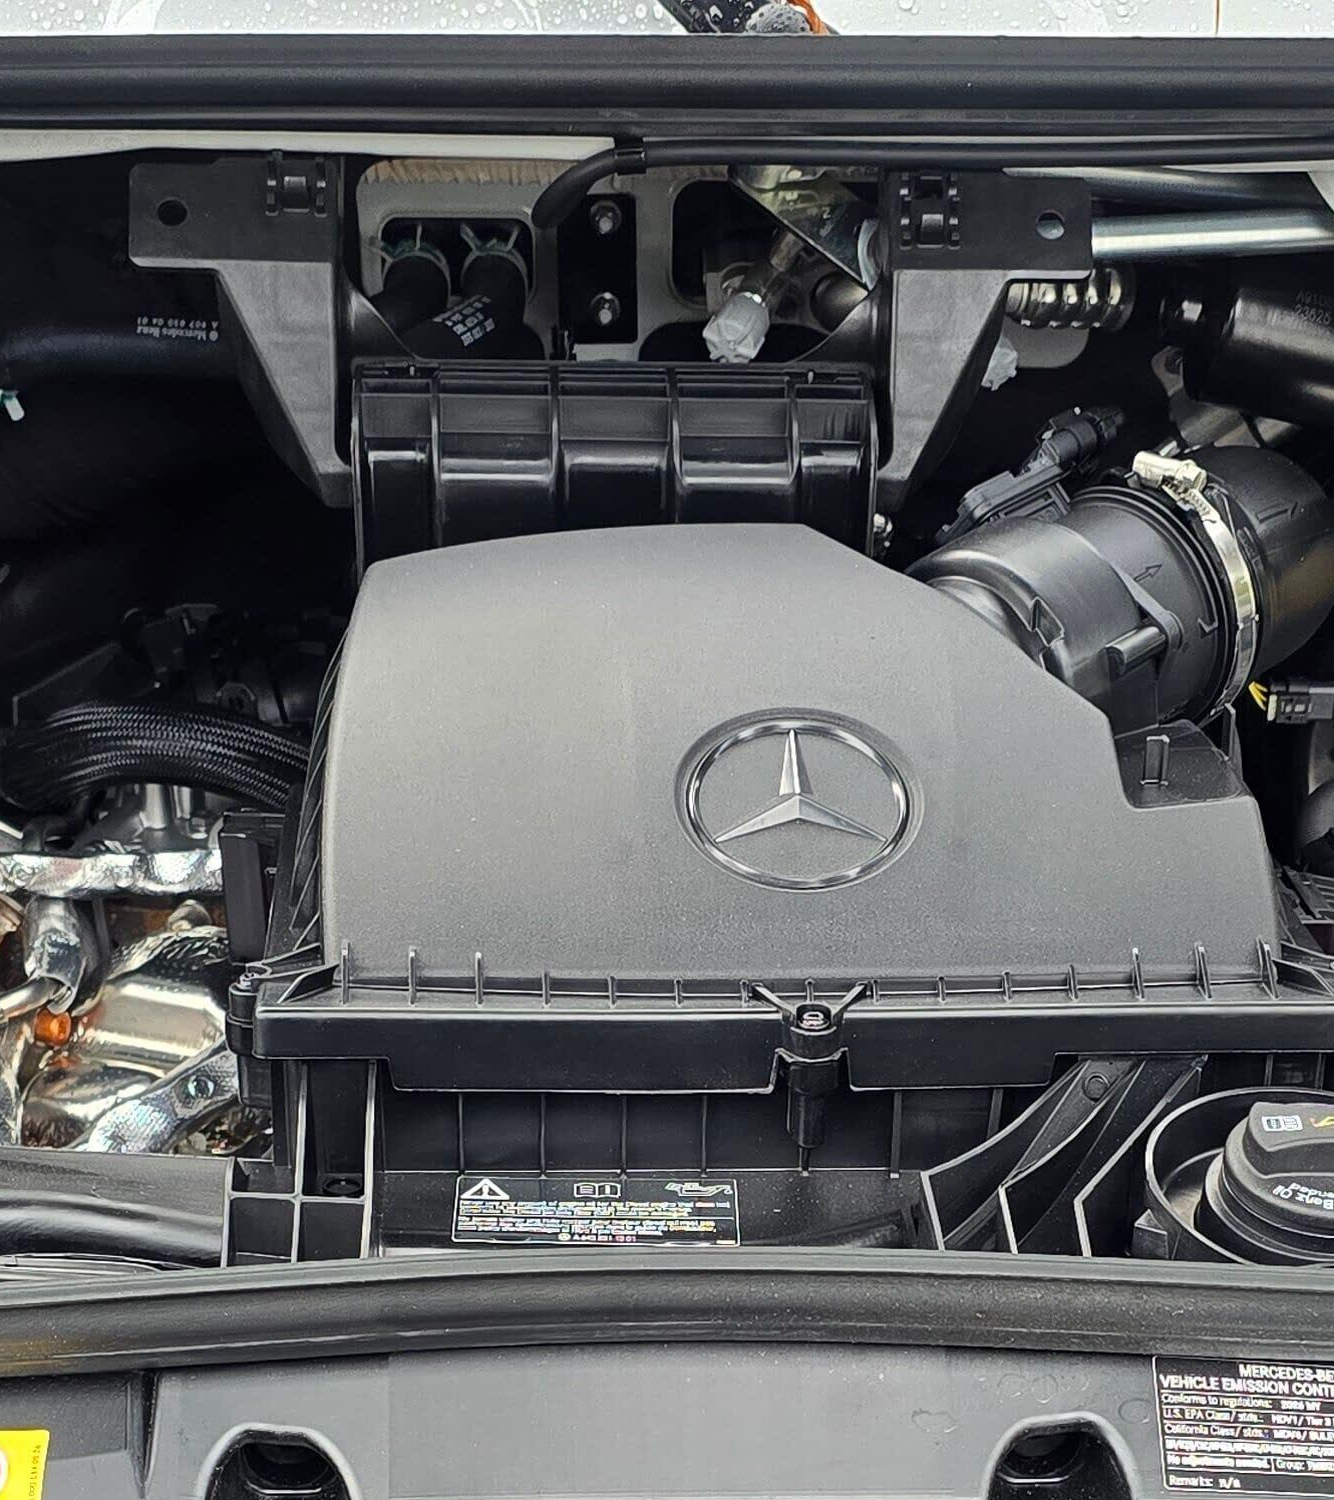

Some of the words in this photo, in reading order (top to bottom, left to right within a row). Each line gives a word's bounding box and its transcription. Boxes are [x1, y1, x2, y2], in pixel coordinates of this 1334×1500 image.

[1272, 1184, 1293, 1199] Oil
[1159, 1374, 1220, 1390] VEHICLE
[1221, 1377, 1289, 1394] EMISSION
[1162, 1393, 1207, 1405] Conforms
[1208, 1395, 1218, 1405] to
[1163, 1408, 1183, 1419] U.S.
[1185, 1409, 1204, 1420] EPA
[1164, 1424, 1208, 1437] California
